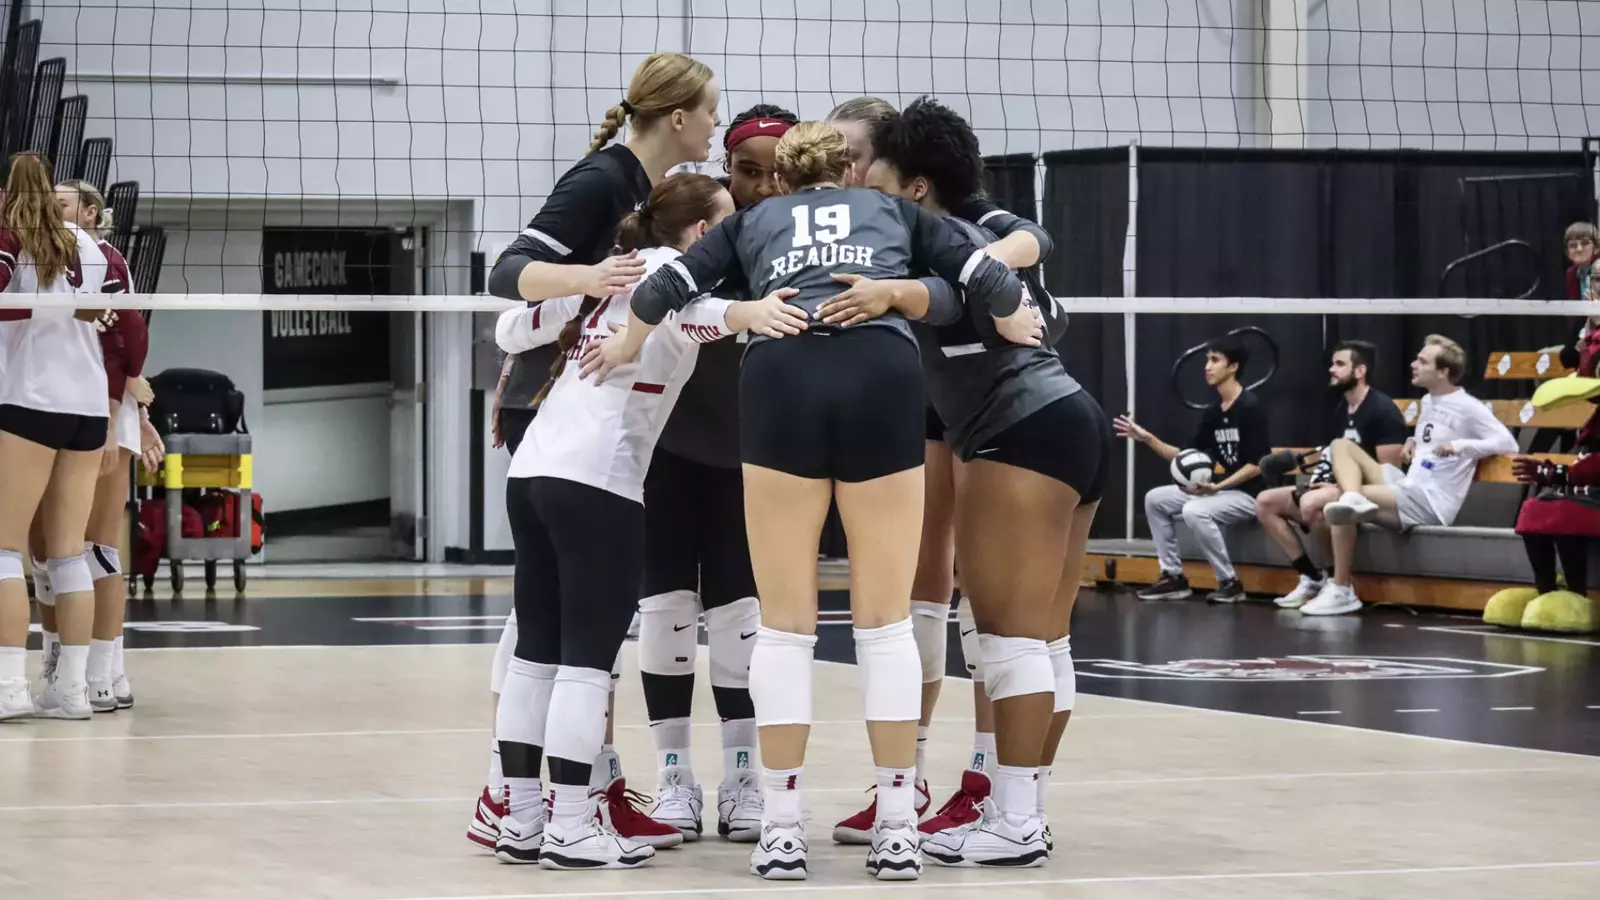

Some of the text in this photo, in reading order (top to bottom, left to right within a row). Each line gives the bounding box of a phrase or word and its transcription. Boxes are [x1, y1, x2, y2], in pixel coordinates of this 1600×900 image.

[792, 203, 850, 247] 19
[274, 250, 347, 288] GAMECOCK
[769, 242, 874, 281] REAUGH
[271, 310, 352, 337] VOLLEYBALL
